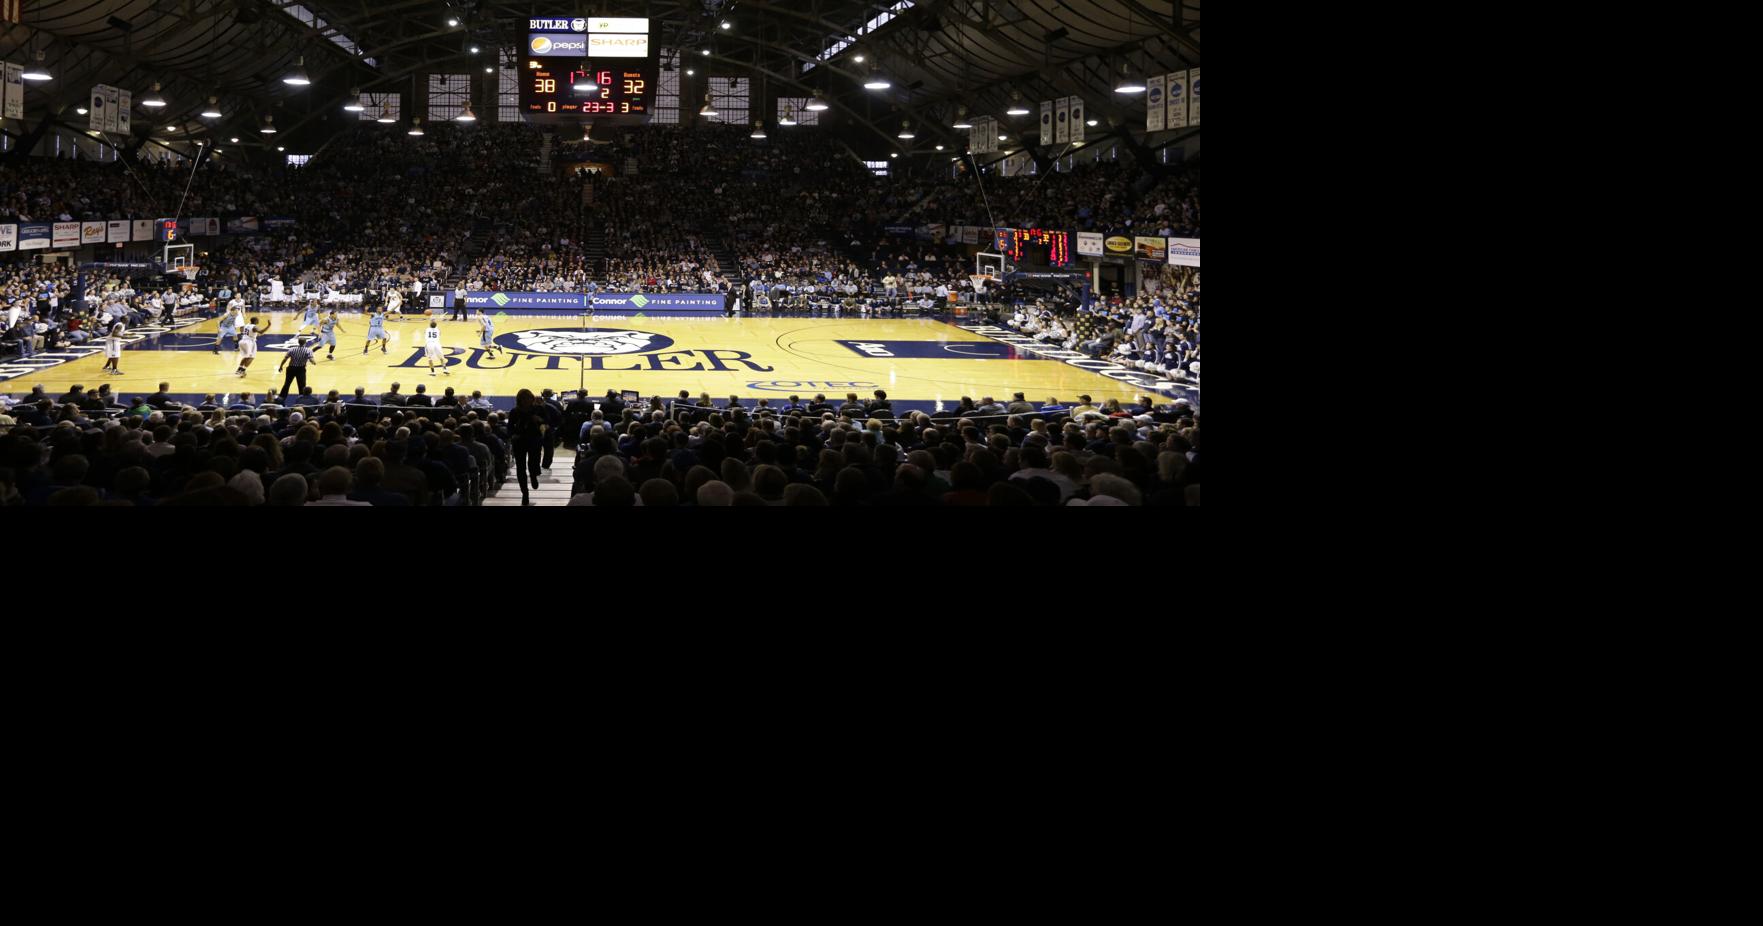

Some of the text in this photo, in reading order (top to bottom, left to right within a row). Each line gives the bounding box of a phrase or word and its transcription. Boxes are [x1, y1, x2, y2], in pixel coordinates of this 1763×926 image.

[530, 20, 568, 29] BUTLER
[553, 42, 584, 51] pepsi
[535, 79, 555, 92] 38
[624, 80, 644, 94] 32
[601, 88, 609, 98] 2
[547, 102, 556, 112] 0
[621, 102, 629, 113] 3
[388, 346, 774, 372] BUTLER
